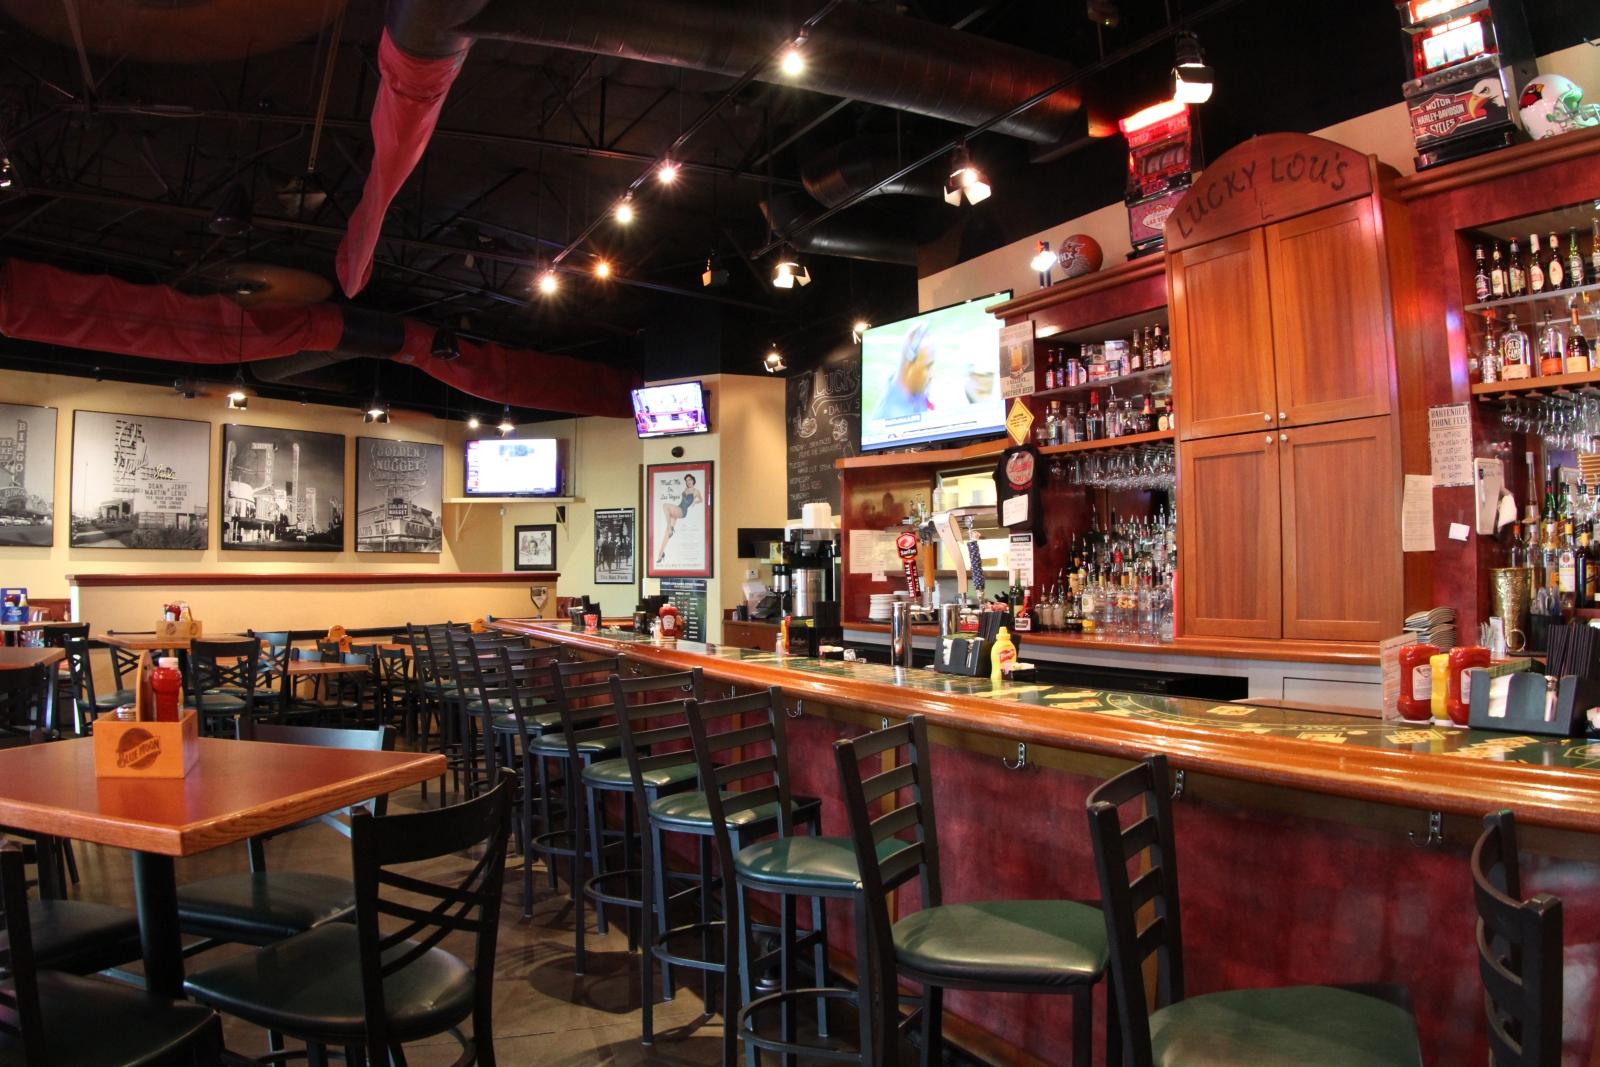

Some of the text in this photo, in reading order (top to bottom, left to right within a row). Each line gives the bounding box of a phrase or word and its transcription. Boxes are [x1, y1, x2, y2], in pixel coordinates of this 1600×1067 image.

[1425, 98, 1451, 111] MOTOR
[1417, 104, 1465, 126] HARLEY-DAVIDSON
[1429, 118, 1456, 134] CYCLES
[1176, 151, 1349, 240] LUCKY LOU'S
[1431, 407, 1467, 418] BARTENDER
[1432, 418, 1452, 427] PHONE
[15, 422, 27, 473] BINGO
[375, 458, 420, 471] NUGGET
[117, 739, 160, 768] BLUE MOON
